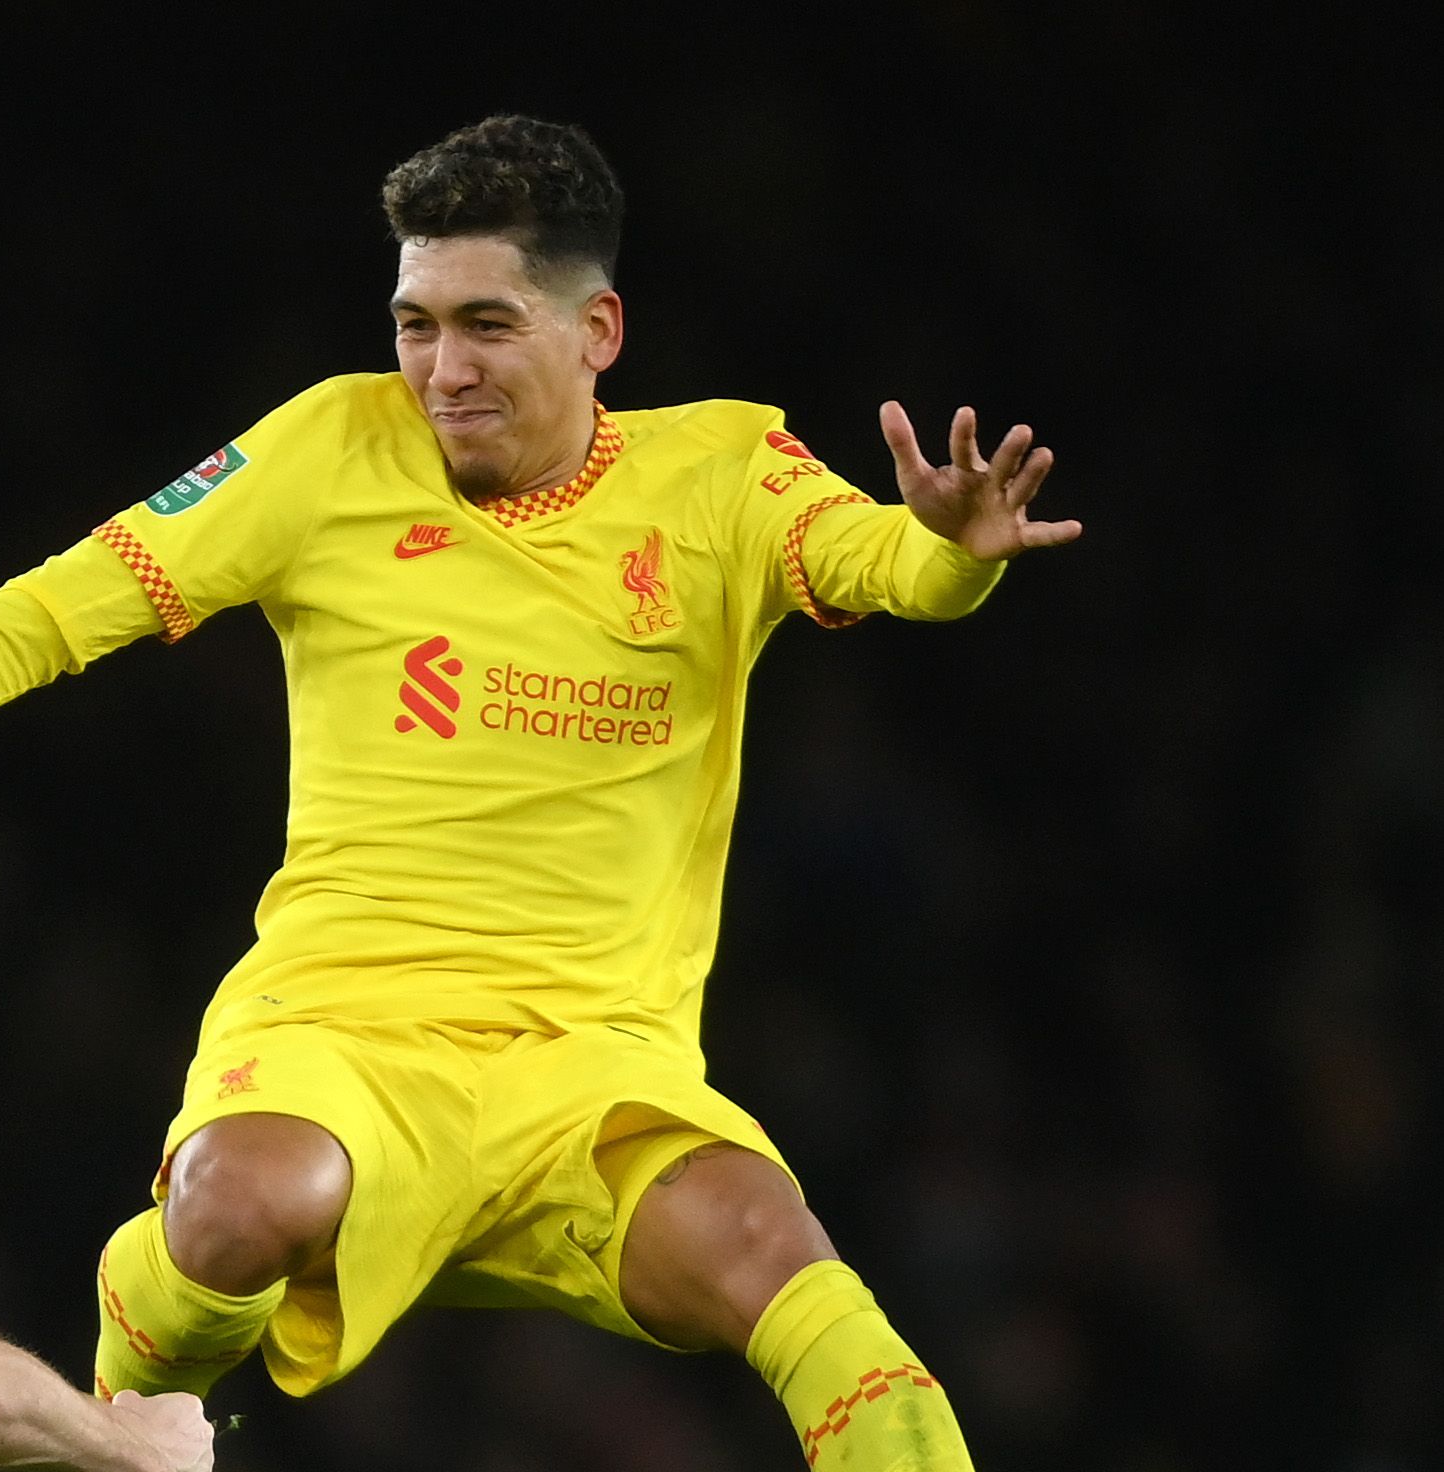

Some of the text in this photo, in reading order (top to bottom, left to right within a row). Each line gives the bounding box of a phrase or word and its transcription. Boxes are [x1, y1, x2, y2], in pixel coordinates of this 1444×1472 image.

[172, 480, 192, 494] up
[184, 470, 214, 491] abao
[760, 461, 824, 496] Exp
[405, 524, 452, 546] NIKE
[483, 662, 673, 712] standard
[479, 698, 673, 746] chartered
